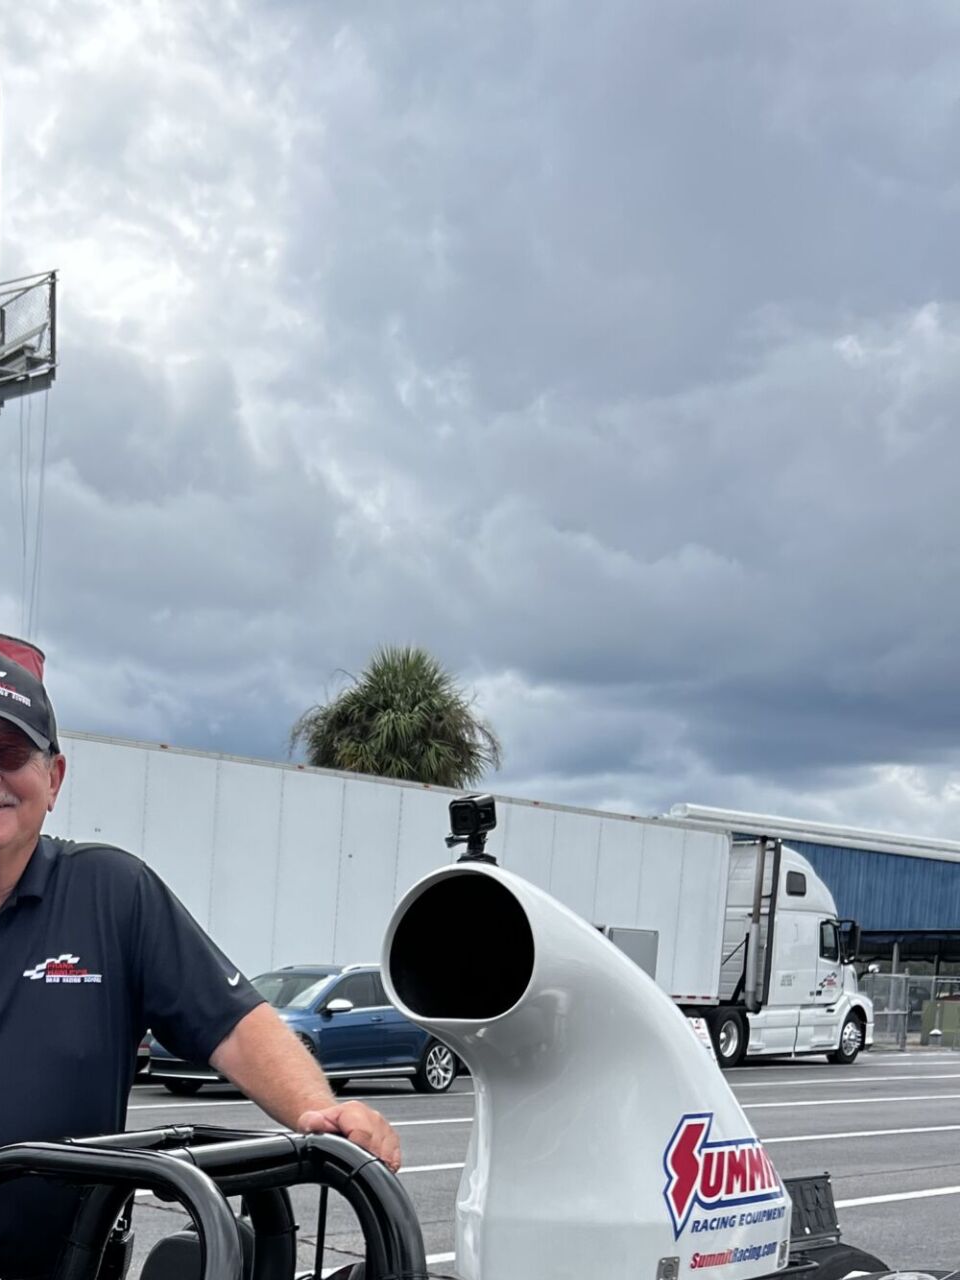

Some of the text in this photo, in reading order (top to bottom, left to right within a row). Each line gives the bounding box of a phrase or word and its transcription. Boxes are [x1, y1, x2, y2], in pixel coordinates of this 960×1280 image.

[690, 1206, 786, 1233] RACING EQUIPMENT
[689, 1241, 778, 1269] SummitRacing.com
